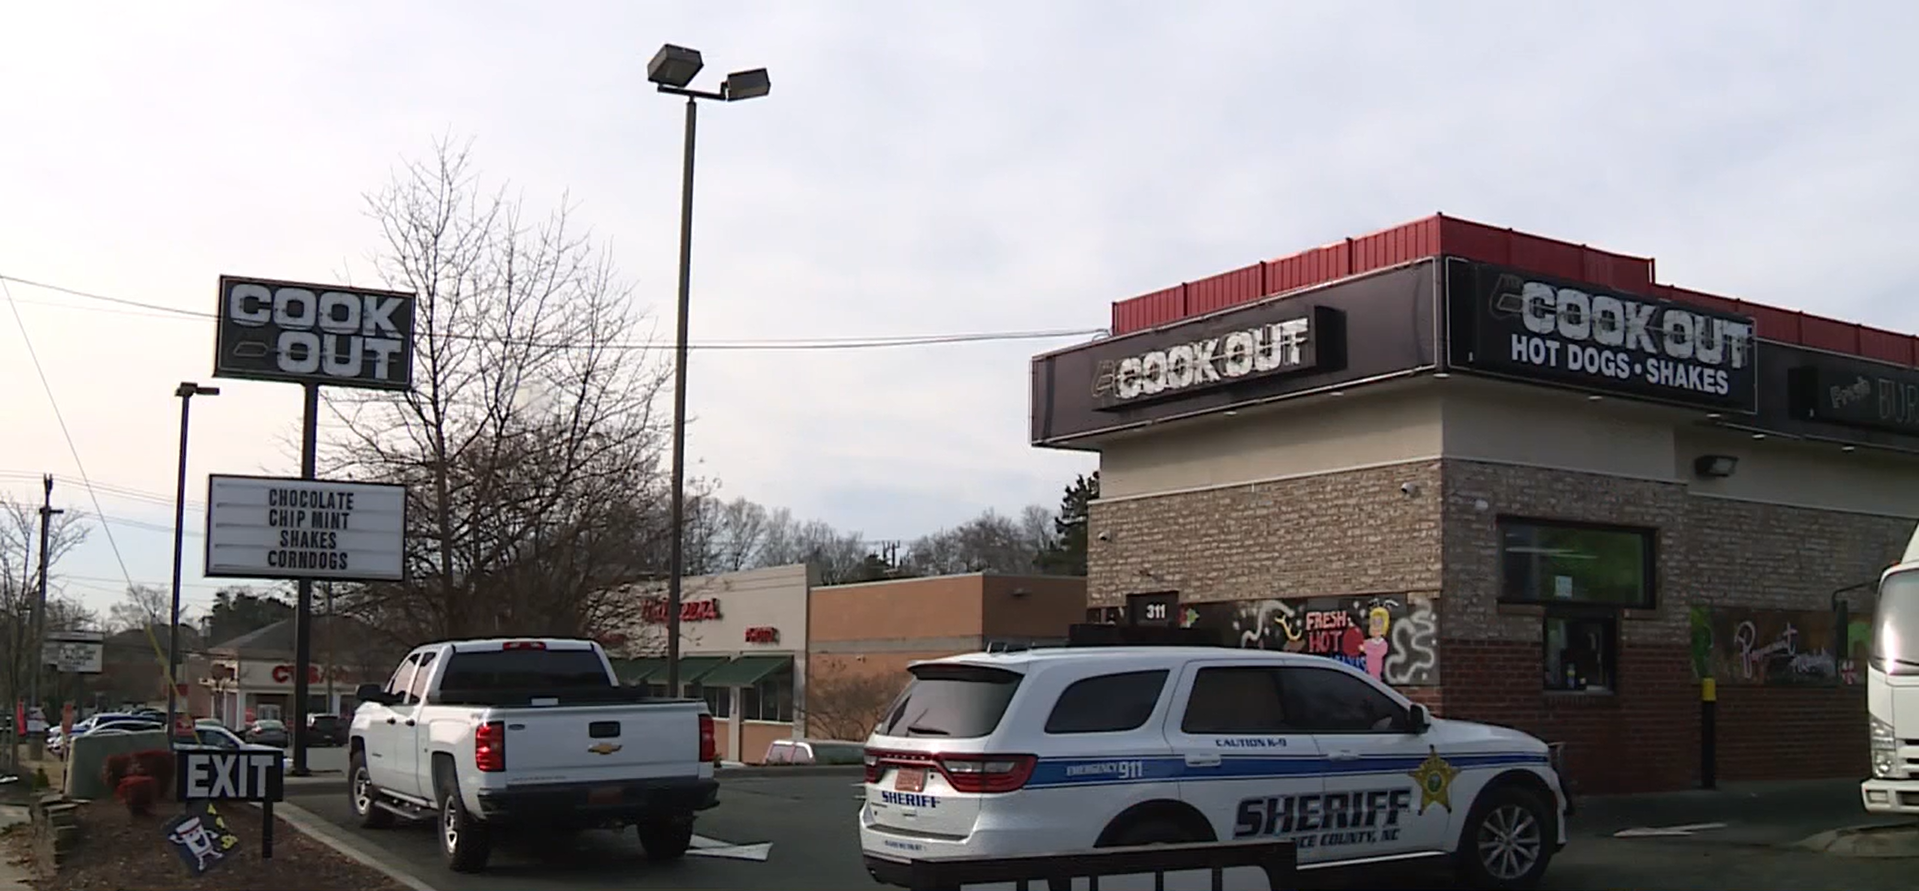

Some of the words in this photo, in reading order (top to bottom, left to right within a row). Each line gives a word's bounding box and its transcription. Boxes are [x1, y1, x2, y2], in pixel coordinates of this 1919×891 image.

[231, 284, 403, 338] COOK
[1522, 282, 1656, 354] COOK
[1662, 309, 1750, 368] OUT
[277, 331, 402, 379] OUT
[1118, 339, 1221, 399] COOK
[1223, 318, 1308, 377] OUT
[1511, 333, 1560, 365] HOT
[1567, 344, 1630, 379] DOGS
[1646, 357, 1729, 395] SHAKES
[268, 488, 354, 510] CHOCOLATE
[268, 509, 306, 528] CHIP
[311, 510, 350, 531] MINT
[279, 530, 337, 550] SHAKES
[267, 550, 349, 571] CORNDOGS
[1146, 603, 1166, 619] 311
[1306, 611, 1347, 630] FRESH
[1309, 630, 1342, 653] HOT
[1216, 738, 1266, 748] CAUTION
[1268, 737, 1287, 748] K-9
[186, 754, 274, 798] EXIT
[1118, 760, 1143, 779] 911
[882, 790, 940, 808] SHERIFF
[1233, 787, 1412, 838] SHERIFF
[1320, 829, 1377, 848] COUNTY,
[1381, 828, 1401, 842] NC
